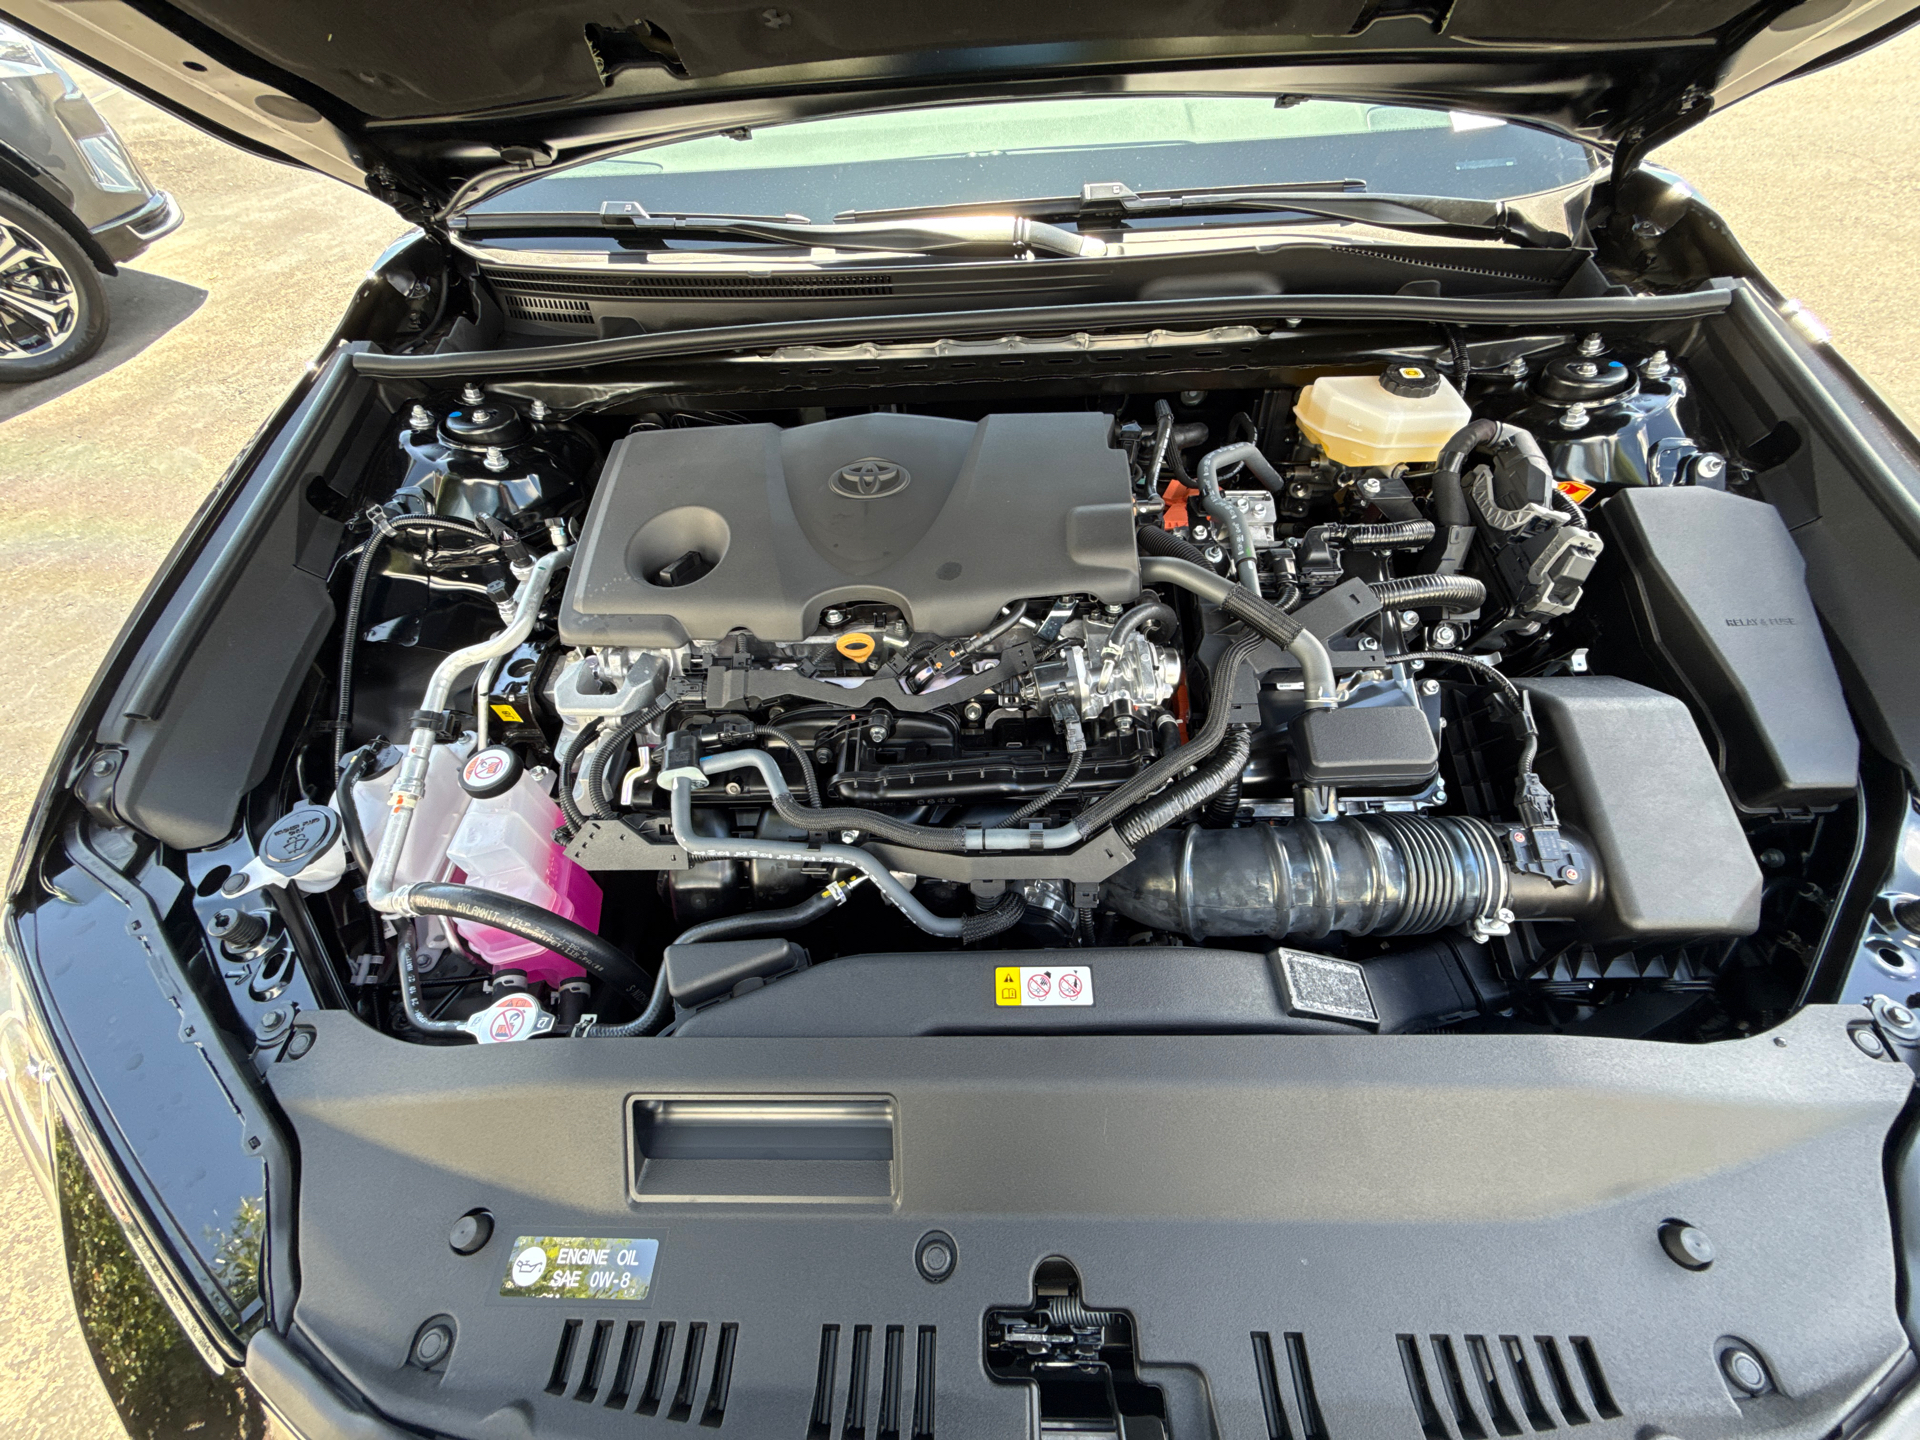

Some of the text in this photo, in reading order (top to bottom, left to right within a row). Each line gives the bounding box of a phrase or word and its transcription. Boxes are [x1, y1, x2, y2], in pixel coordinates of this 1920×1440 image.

[1725, 618, 1758, 627] RELAY
[1769, 617, 1797, 626] FUSE
[556, 1248, 639, 1266] ENGINE OIL
[551, 1270, 631, 1288] SAE 0W-8
